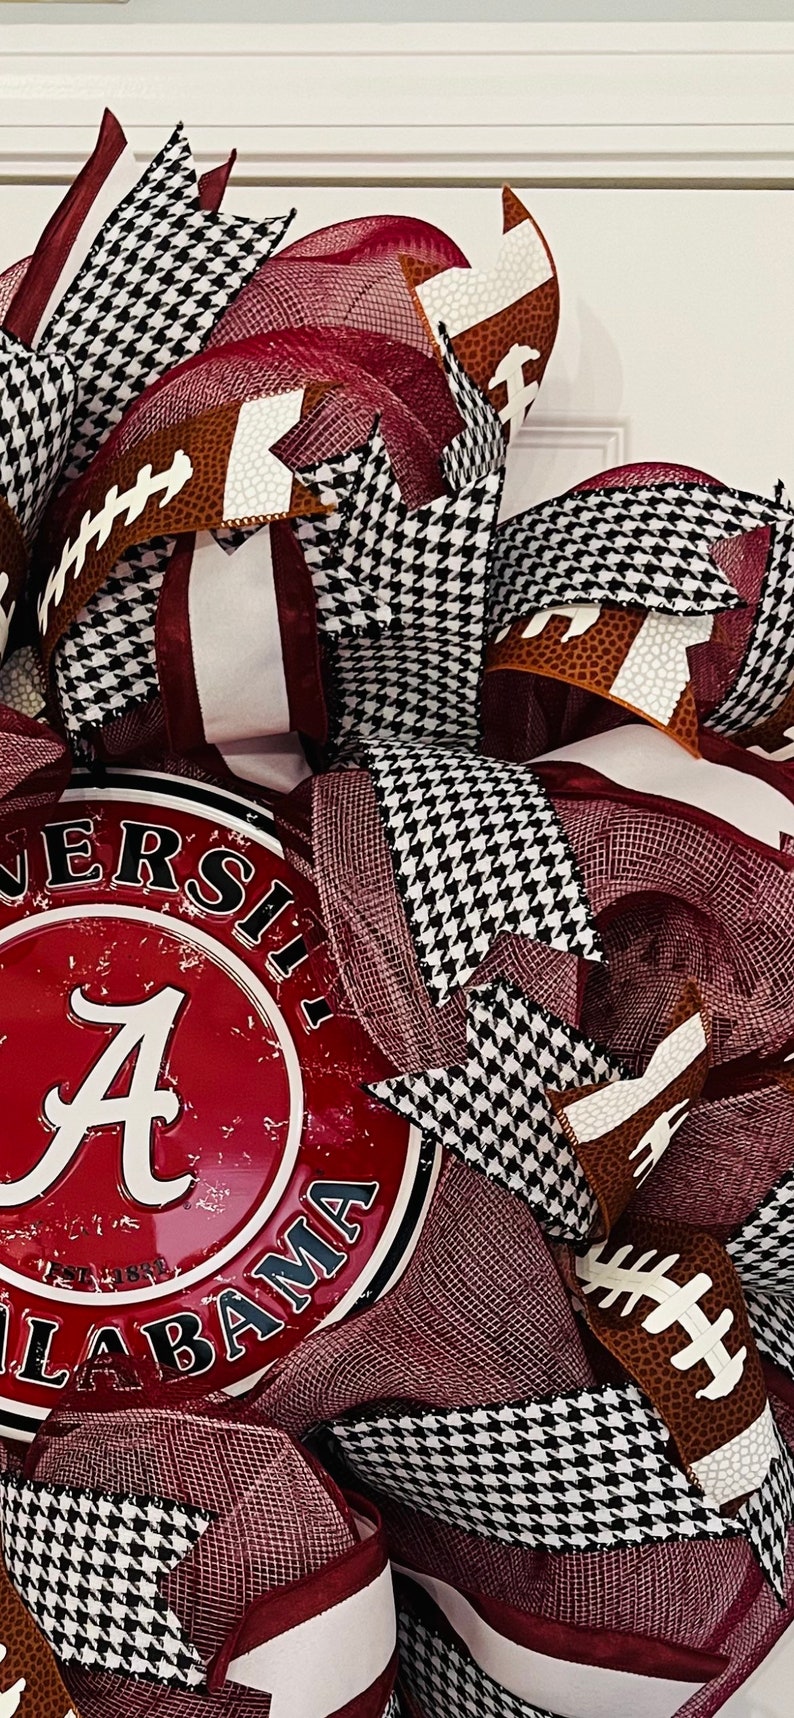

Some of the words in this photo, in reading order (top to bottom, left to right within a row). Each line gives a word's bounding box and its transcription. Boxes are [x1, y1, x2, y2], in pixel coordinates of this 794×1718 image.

[0, 985, 196, 1207] A
[0, 1180, 379, 1391] LABAMA
[114, 1256, 168, 1284] 1831
